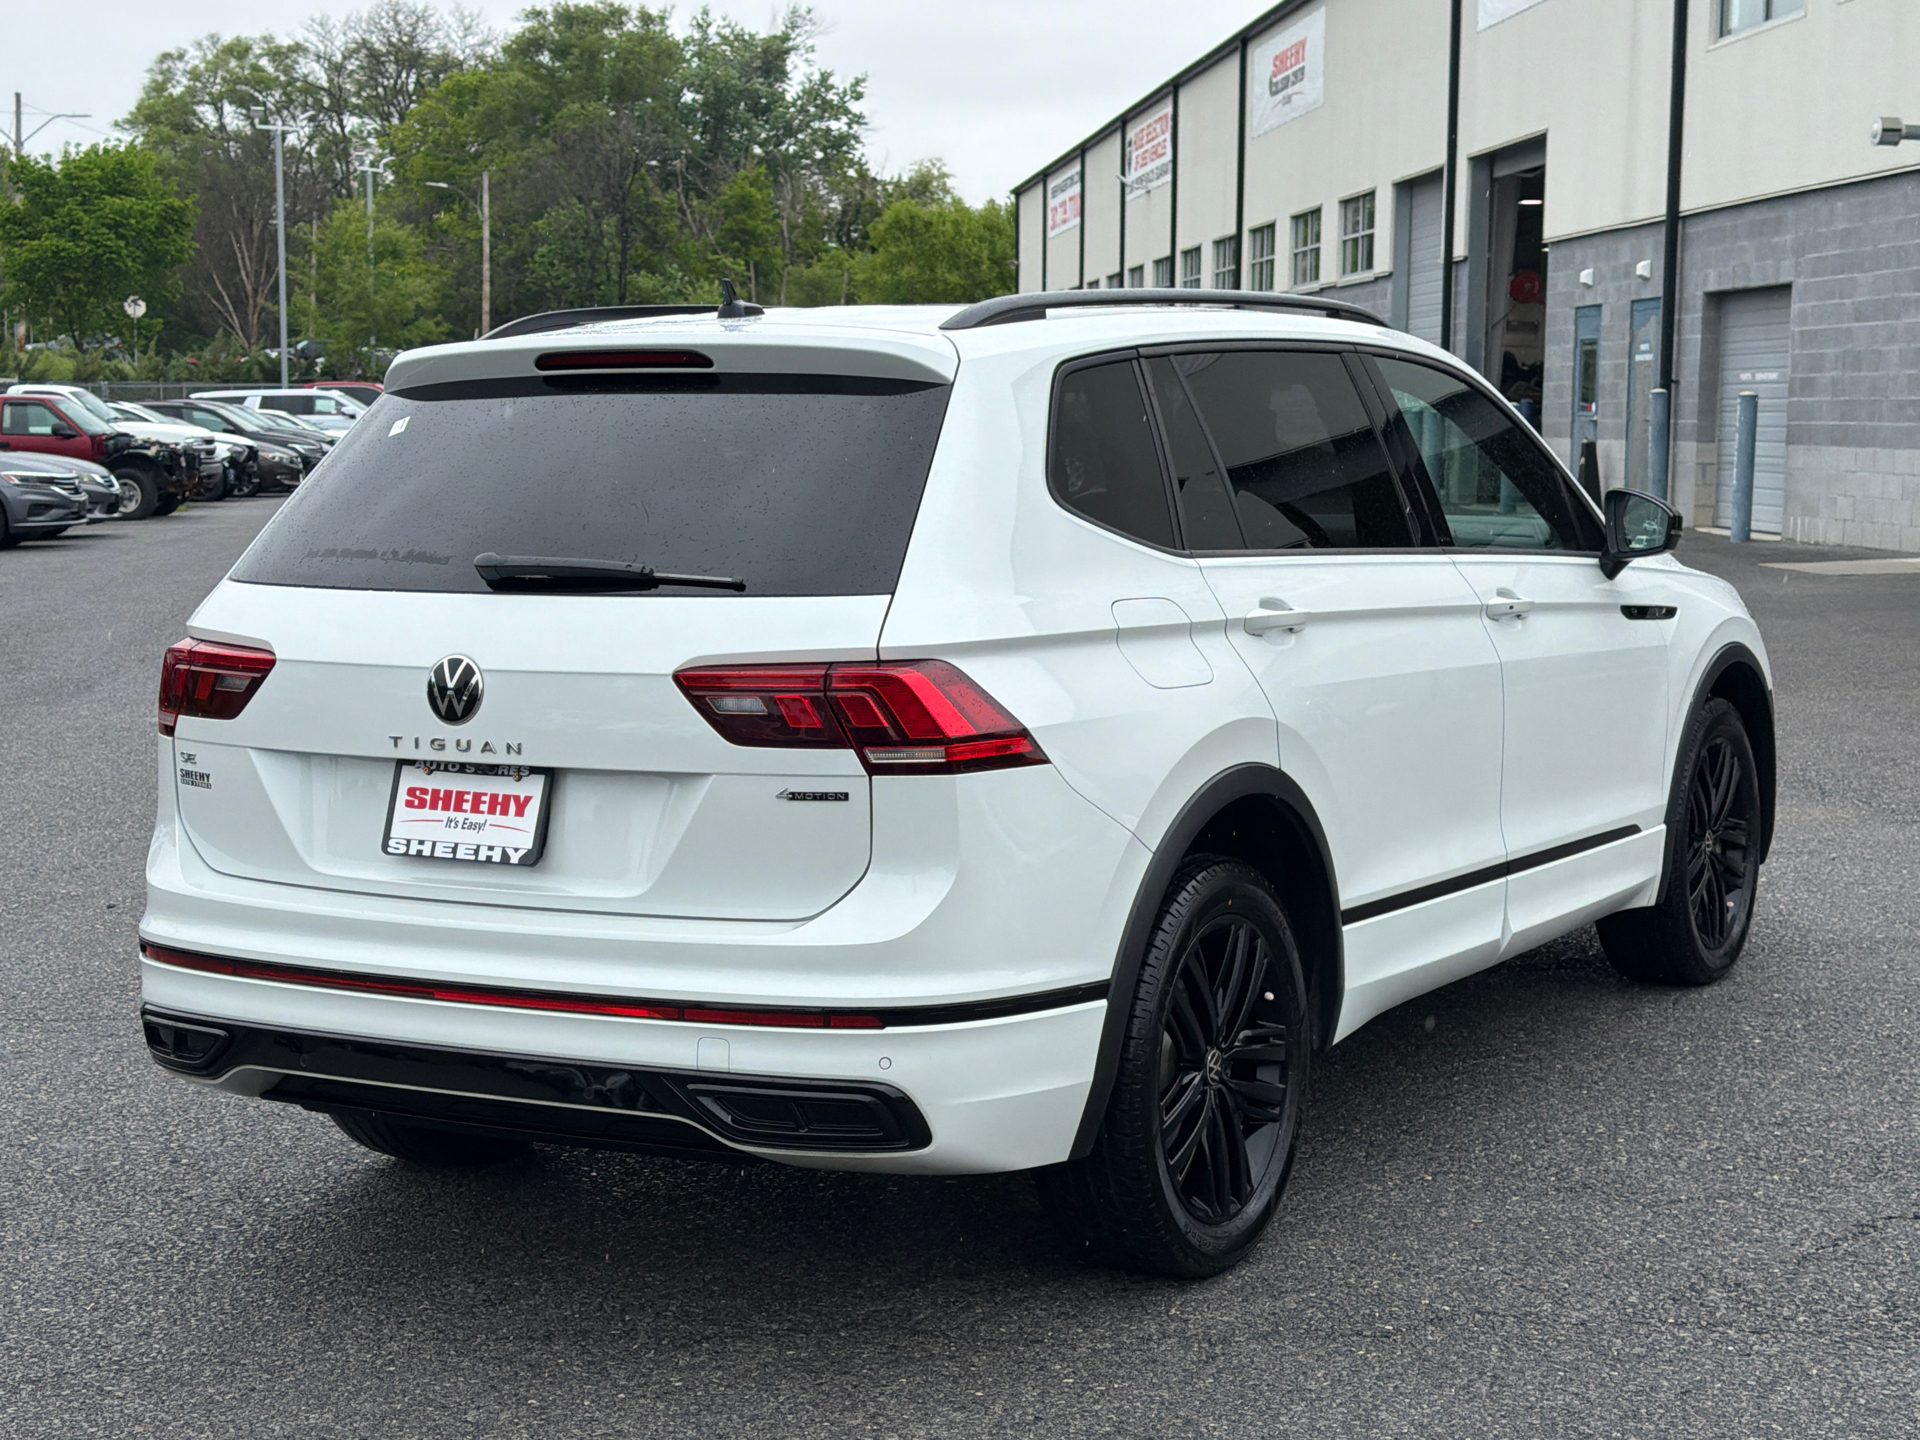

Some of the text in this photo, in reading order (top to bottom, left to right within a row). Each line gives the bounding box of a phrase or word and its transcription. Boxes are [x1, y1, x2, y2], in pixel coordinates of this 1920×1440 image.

[388, 735, 523, 756] TIGUAN
[180, 768, 210, 782] SHEEHY
[414, 759, 460, 772] AUTO
[405, 786, 533, 818] SHEEHY
[444, 816, 488, 834] It's Easy!
[387, 838, 529, 864] SHEEHY
